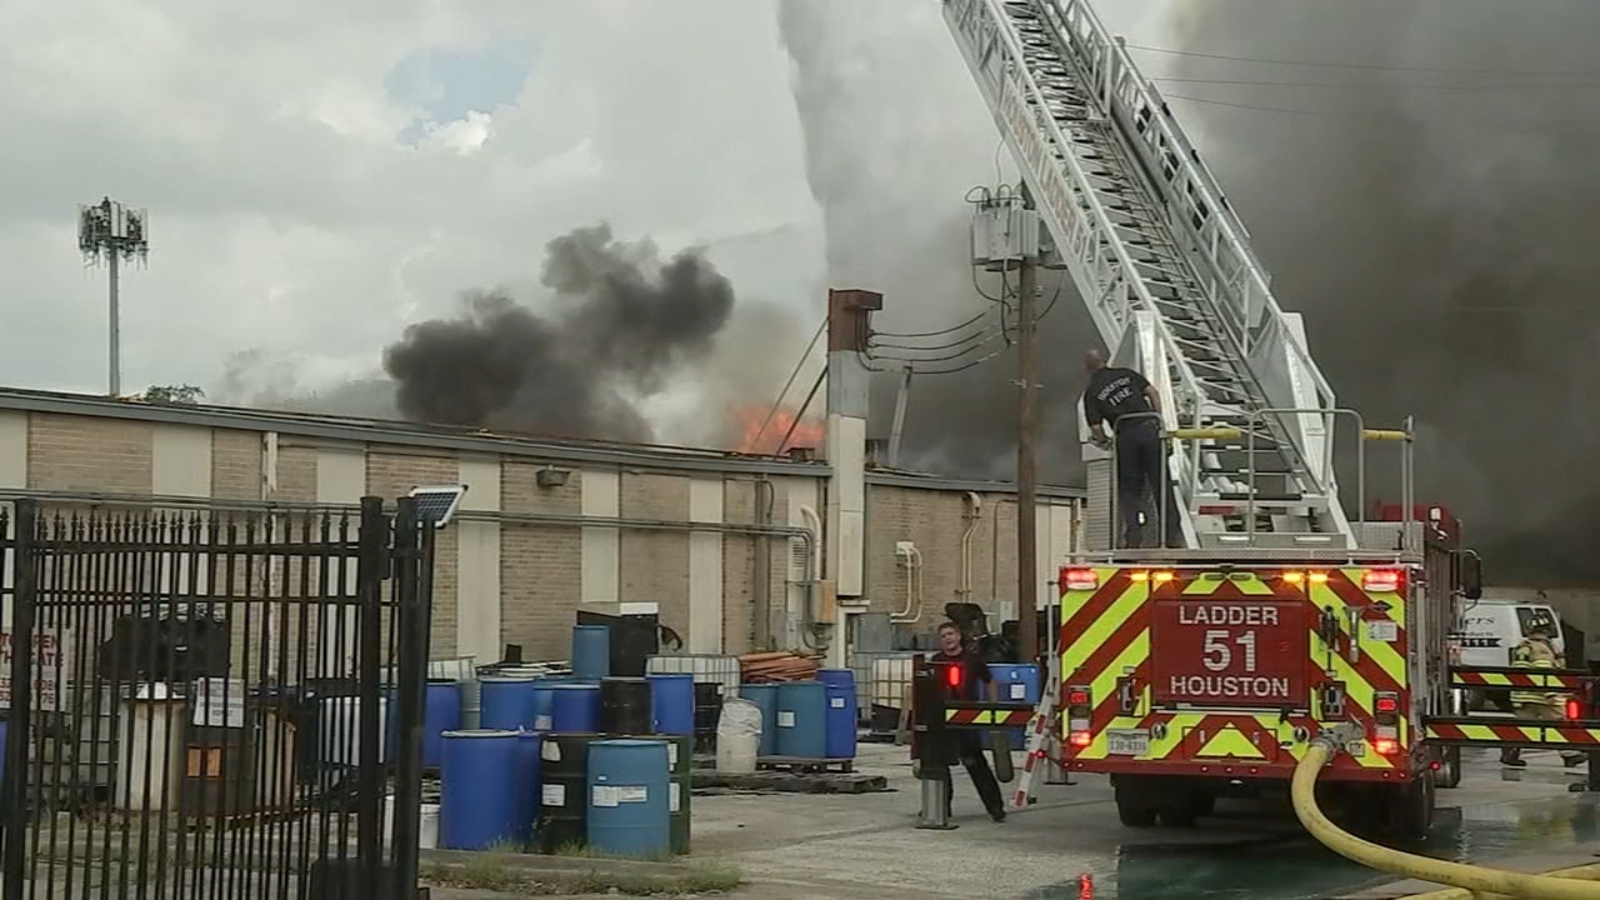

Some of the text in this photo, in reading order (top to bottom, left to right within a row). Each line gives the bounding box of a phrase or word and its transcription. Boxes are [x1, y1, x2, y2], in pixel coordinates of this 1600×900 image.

[1109, 387, 1133, 406] FIRE
[1179, 605, 1279, 626] LADDER
[1203, 629, 1256, 672] 51
[1170, 676, 1289, 697] HOUSTON
